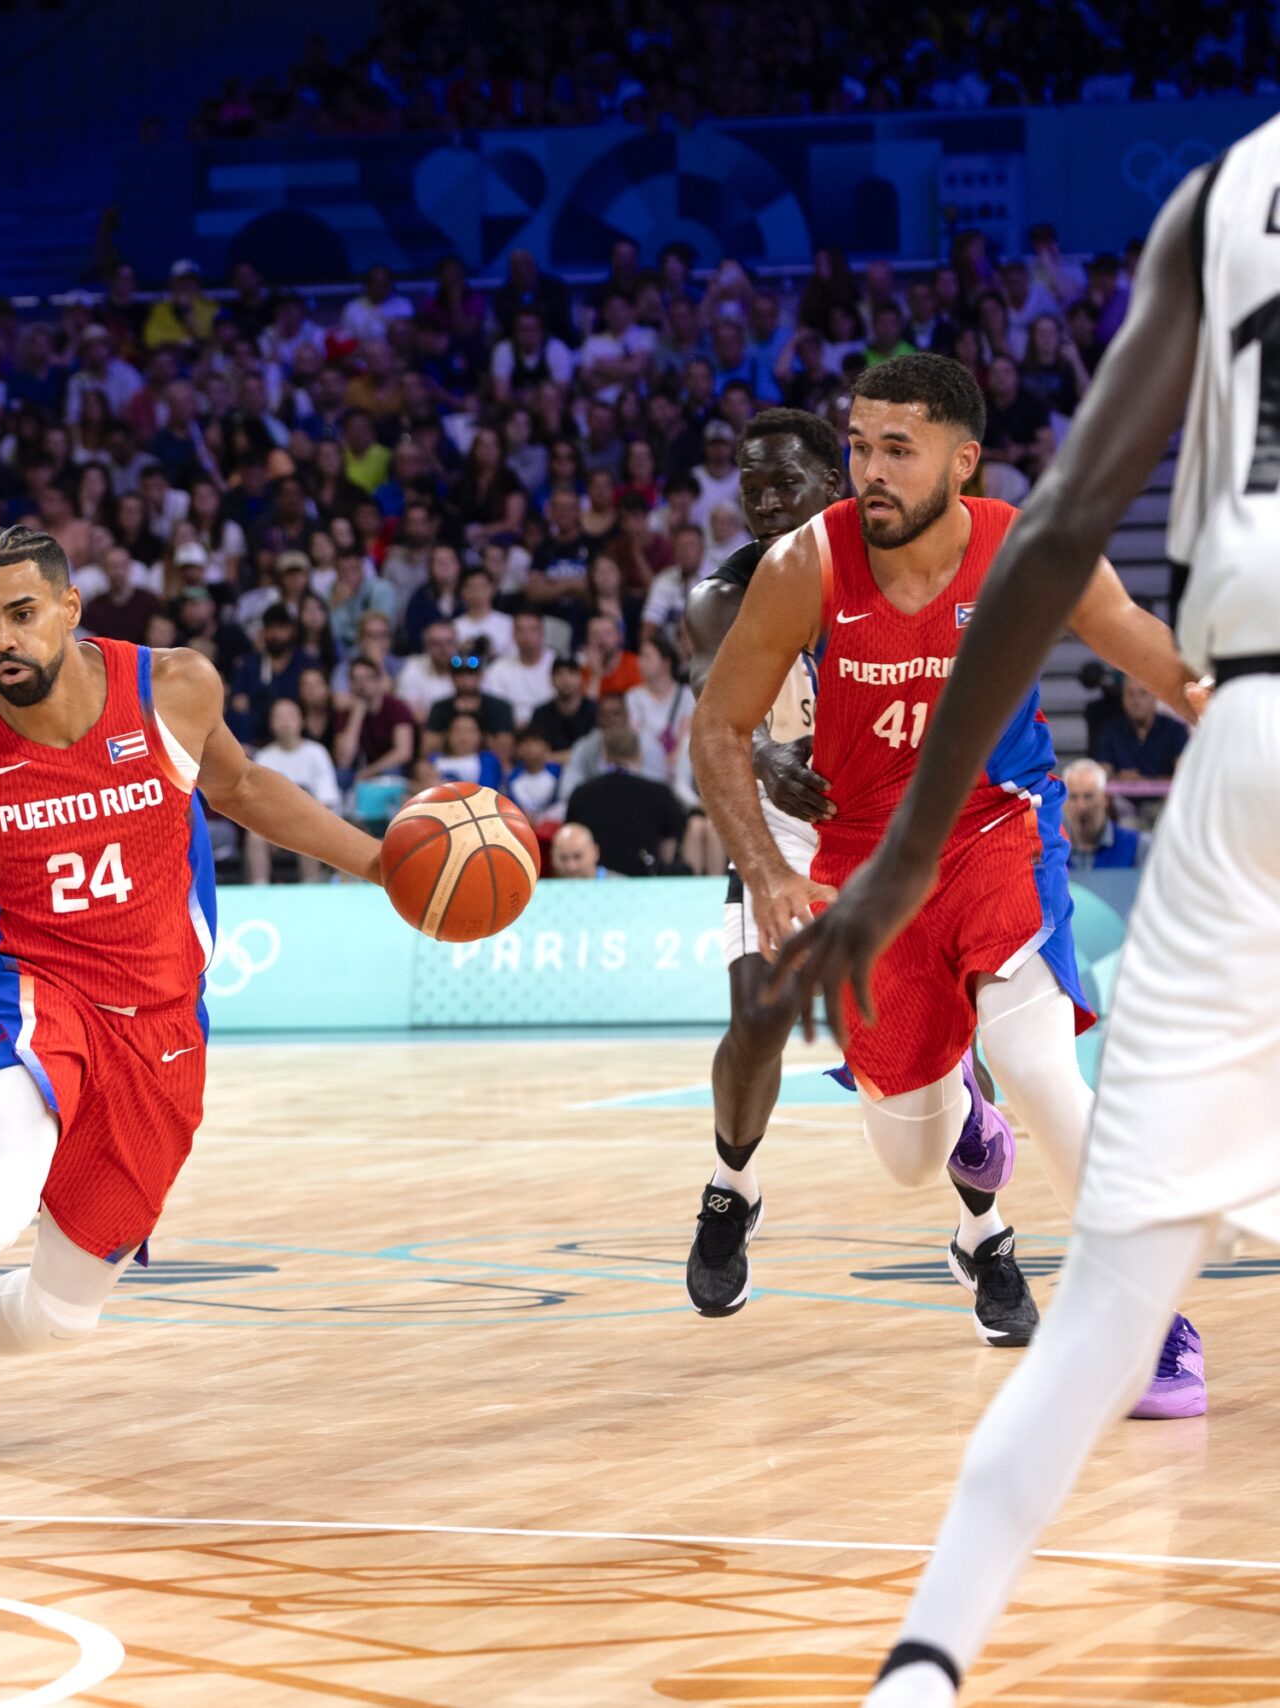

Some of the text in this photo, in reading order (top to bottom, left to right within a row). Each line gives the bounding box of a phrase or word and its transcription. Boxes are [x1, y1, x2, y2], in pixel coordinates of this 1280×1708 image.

[839, 656, 958, 685] PUERTO RI
[872, 700, 928, 749] 41
[99, 778, 164, 817] RICO
[46, 842, 133, 914] 24
[451, 928, 725, 972] PARIS 20
